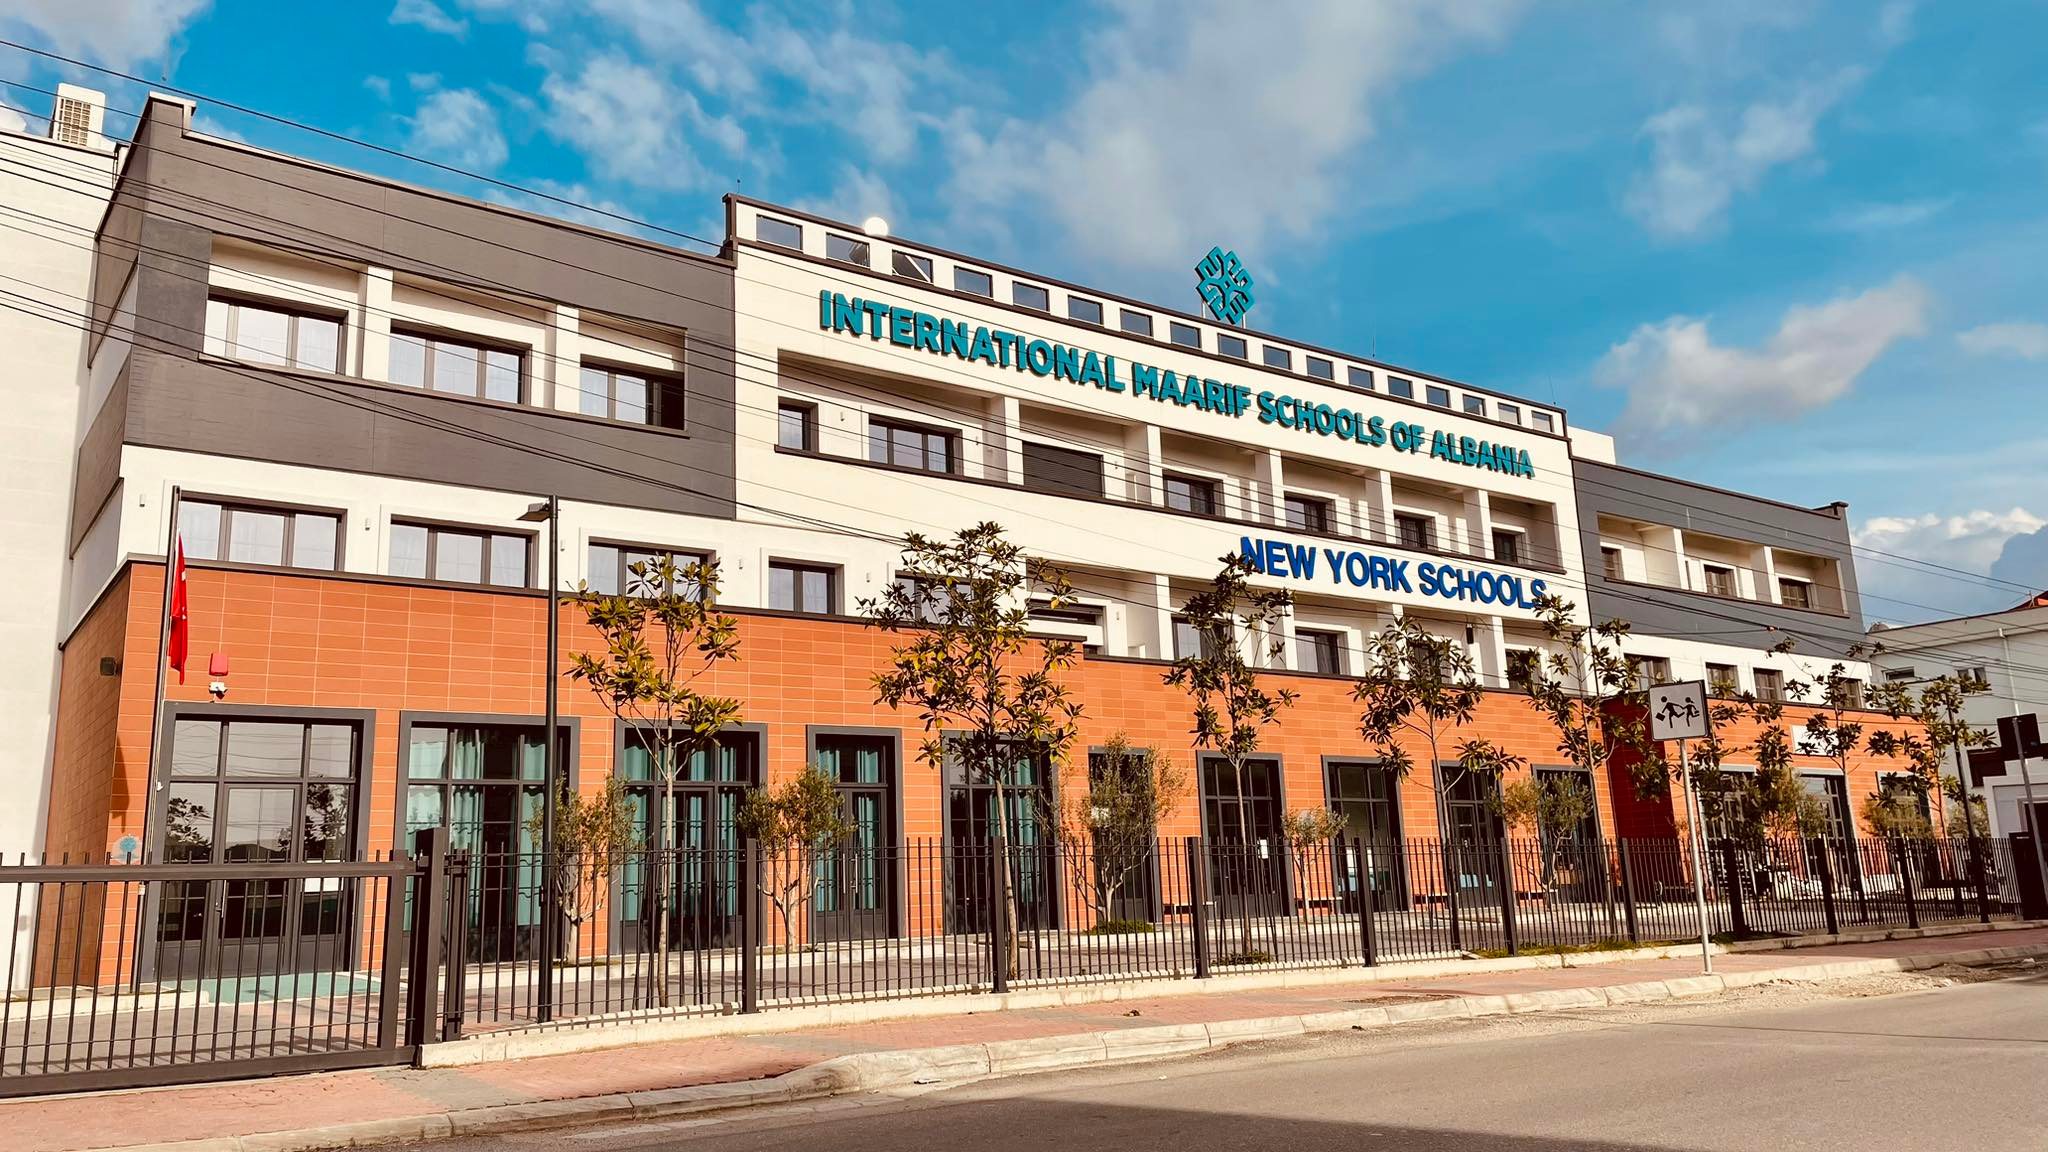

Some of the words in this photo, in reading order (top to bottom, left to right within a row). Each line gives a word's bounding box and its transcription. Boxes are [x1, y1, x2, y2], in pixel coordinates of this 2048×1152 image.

[820, 290, 1127, 393] INTERNATIONAL
[1132, 362, 1252, 418] MAARIF
[1258, 391, 1386, 447] SCHOOLS
[1391, 421, 1425, 453] OF
[1431, 430, 1535, 479] ALBANIA
[1240, 536, 1316, 580] NEW
[1324, 549, 1413, 593] YORK
[1418, 562, 1547, 611] SCHOOLS
